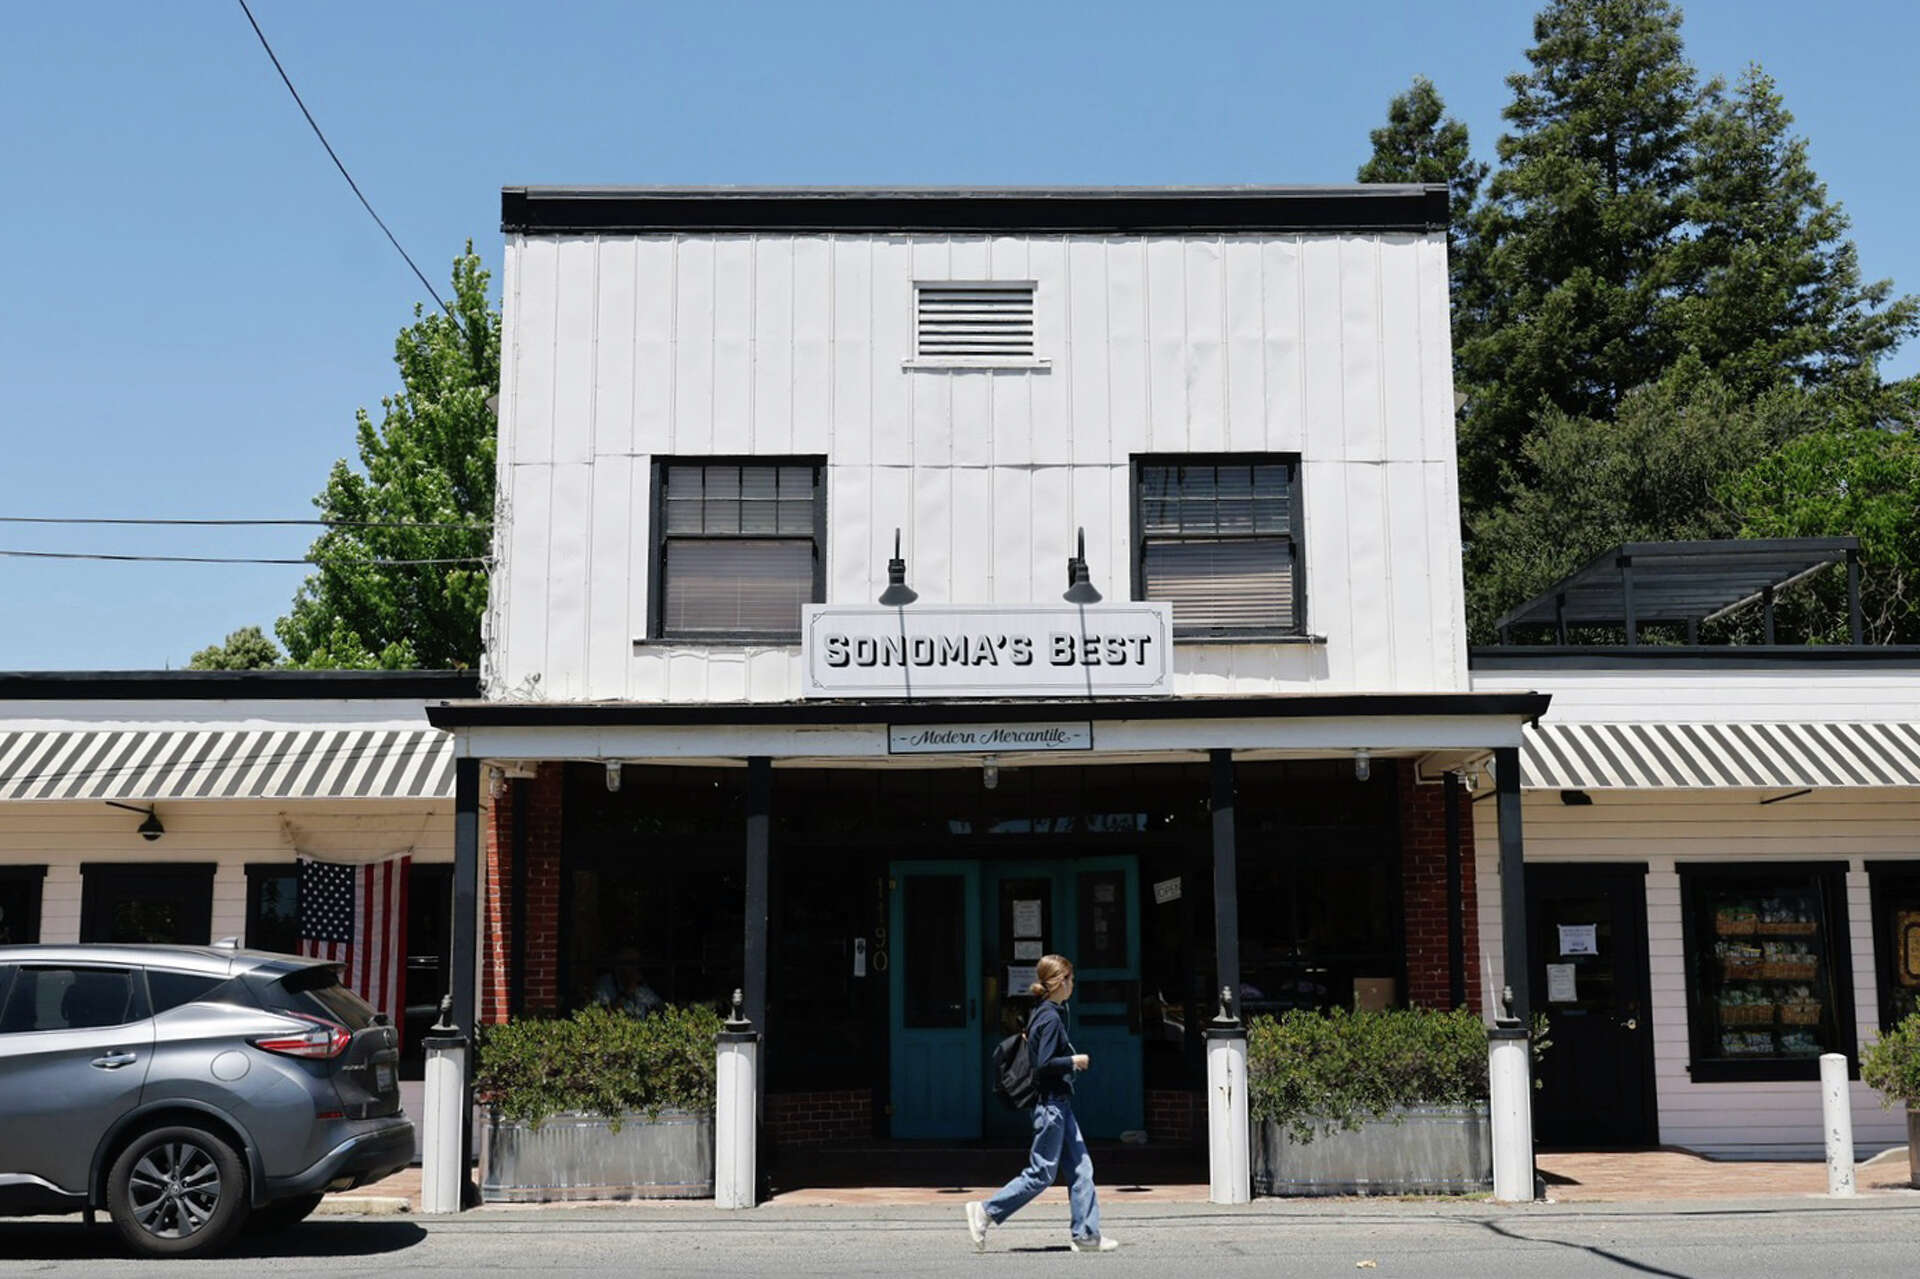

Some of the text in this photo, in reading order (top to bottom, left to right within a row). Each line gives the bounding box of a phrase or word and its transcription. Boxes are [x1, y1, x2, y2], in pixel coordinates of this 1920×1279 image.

[824, 632, 1152, 668] SONOMA'S BEST
[911, 727, 1071, 748] Modern Mercantile
